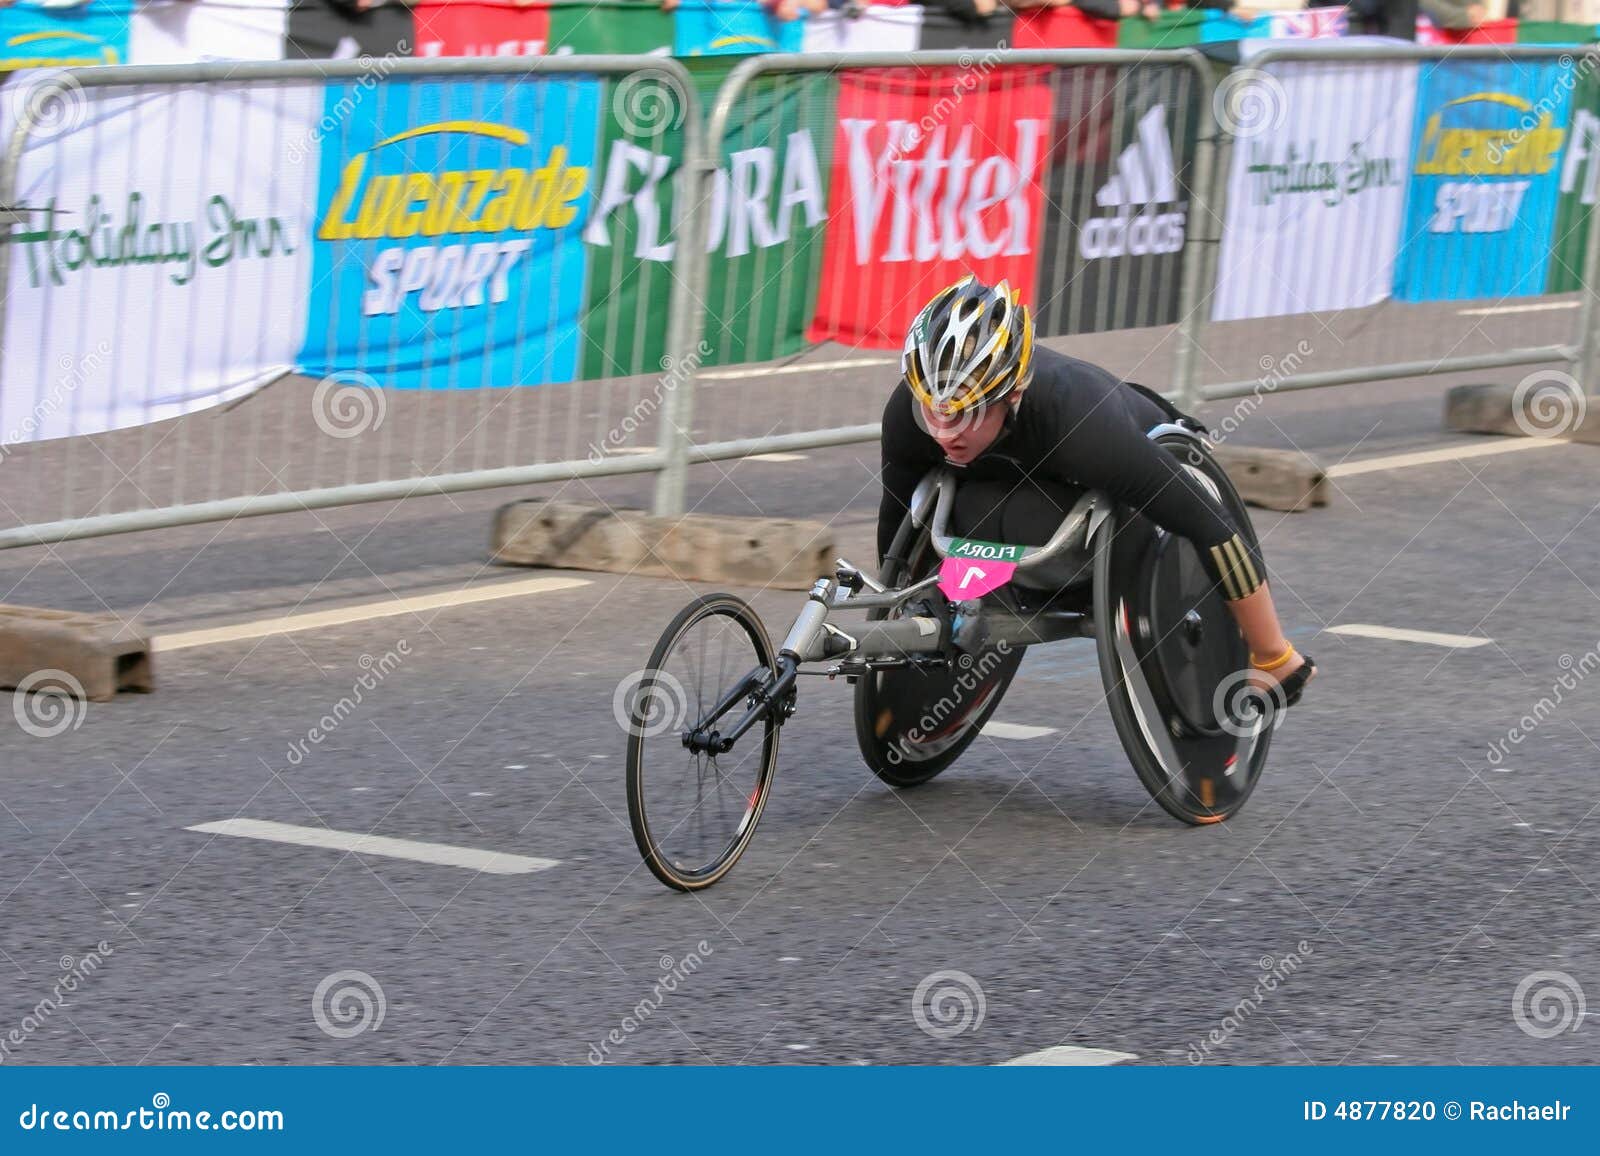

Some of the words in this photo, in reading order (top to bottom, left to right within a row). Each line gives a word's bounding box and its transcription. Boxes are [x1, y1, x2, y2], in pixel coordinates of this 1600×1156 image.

[319, 145, 589, 240] Lucozade
[840, 118, 1042, 265] Vittel
[1080, 201, 1187, 260] adidas
[9, 192, 196, 288] Holiday
[203, 194, 297, 268] Inn
[363, 238, 536, 316] SPORT
